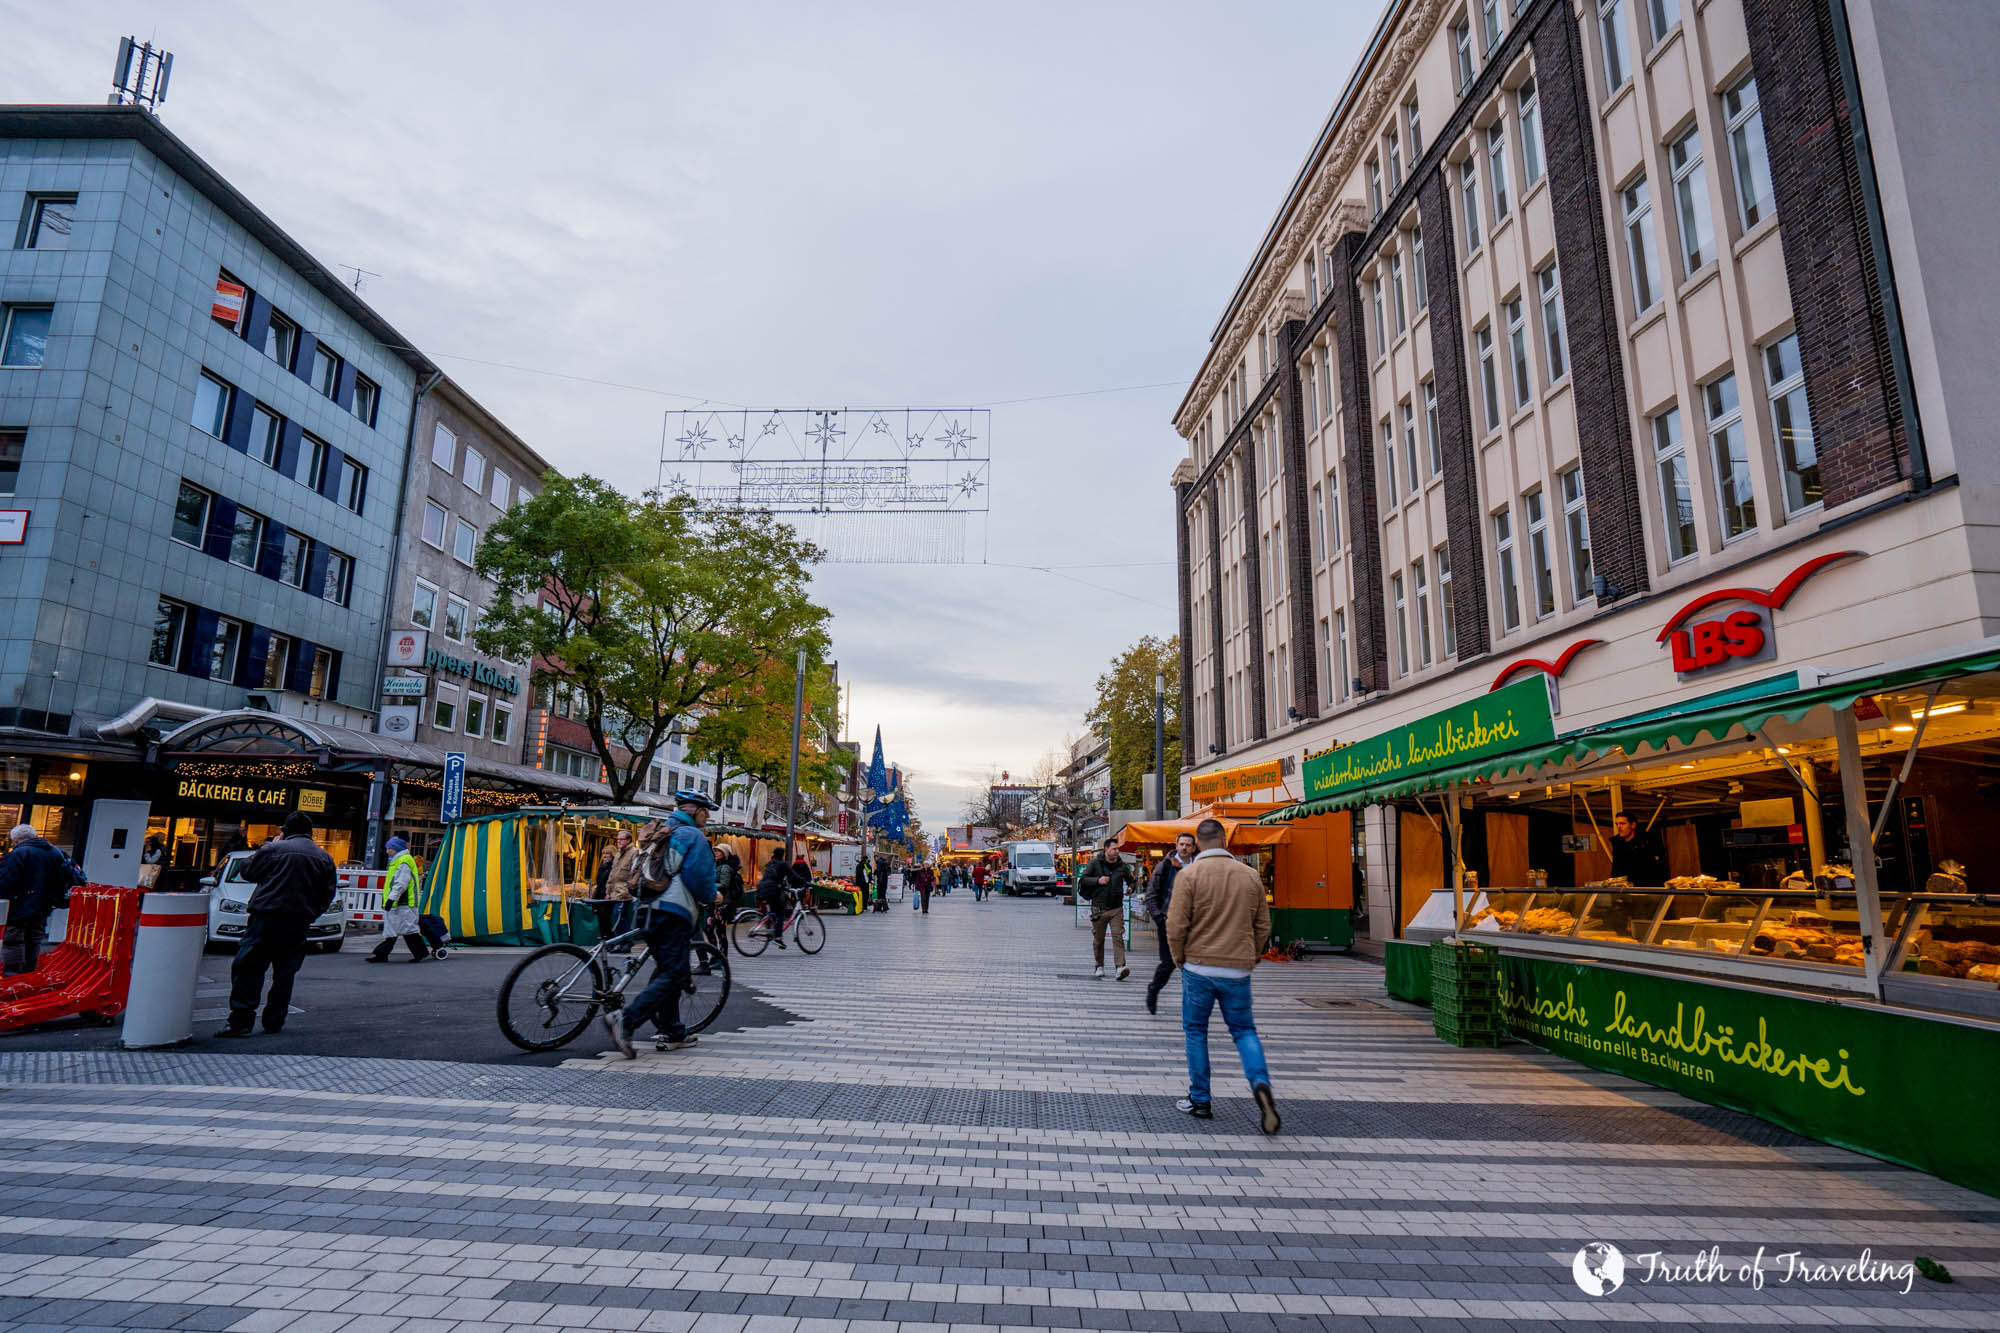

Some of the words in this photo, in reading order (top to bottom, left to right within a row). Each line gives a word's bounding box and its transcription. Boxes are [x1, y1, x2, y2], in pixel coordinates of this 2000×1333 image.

[732, 462, 911, 485] DUISBURGER
[1671, 611, 1765, 672] LBS
[384, 678, 422, 689] Heinrichs
[473, 661, 521, 696] Kölsch
[451, 760, 460, 771] P
[1313, 741, 1402, 791] niederrheinische
[1407, 710, 1519, 766] landbäckerei
[178, 779, 244, 801] BÄCKEREI
[245, 788, 255, 803] &
[257, 788, 287, 806] CAFÉ
[302, 792, 324, 805] DÖBBE
[1541, 1025, 1560, 1039] und
[1641, 1048, 1715, 1084] Backwaren
[1605, 991, 1866, 1096] landbäckerei
